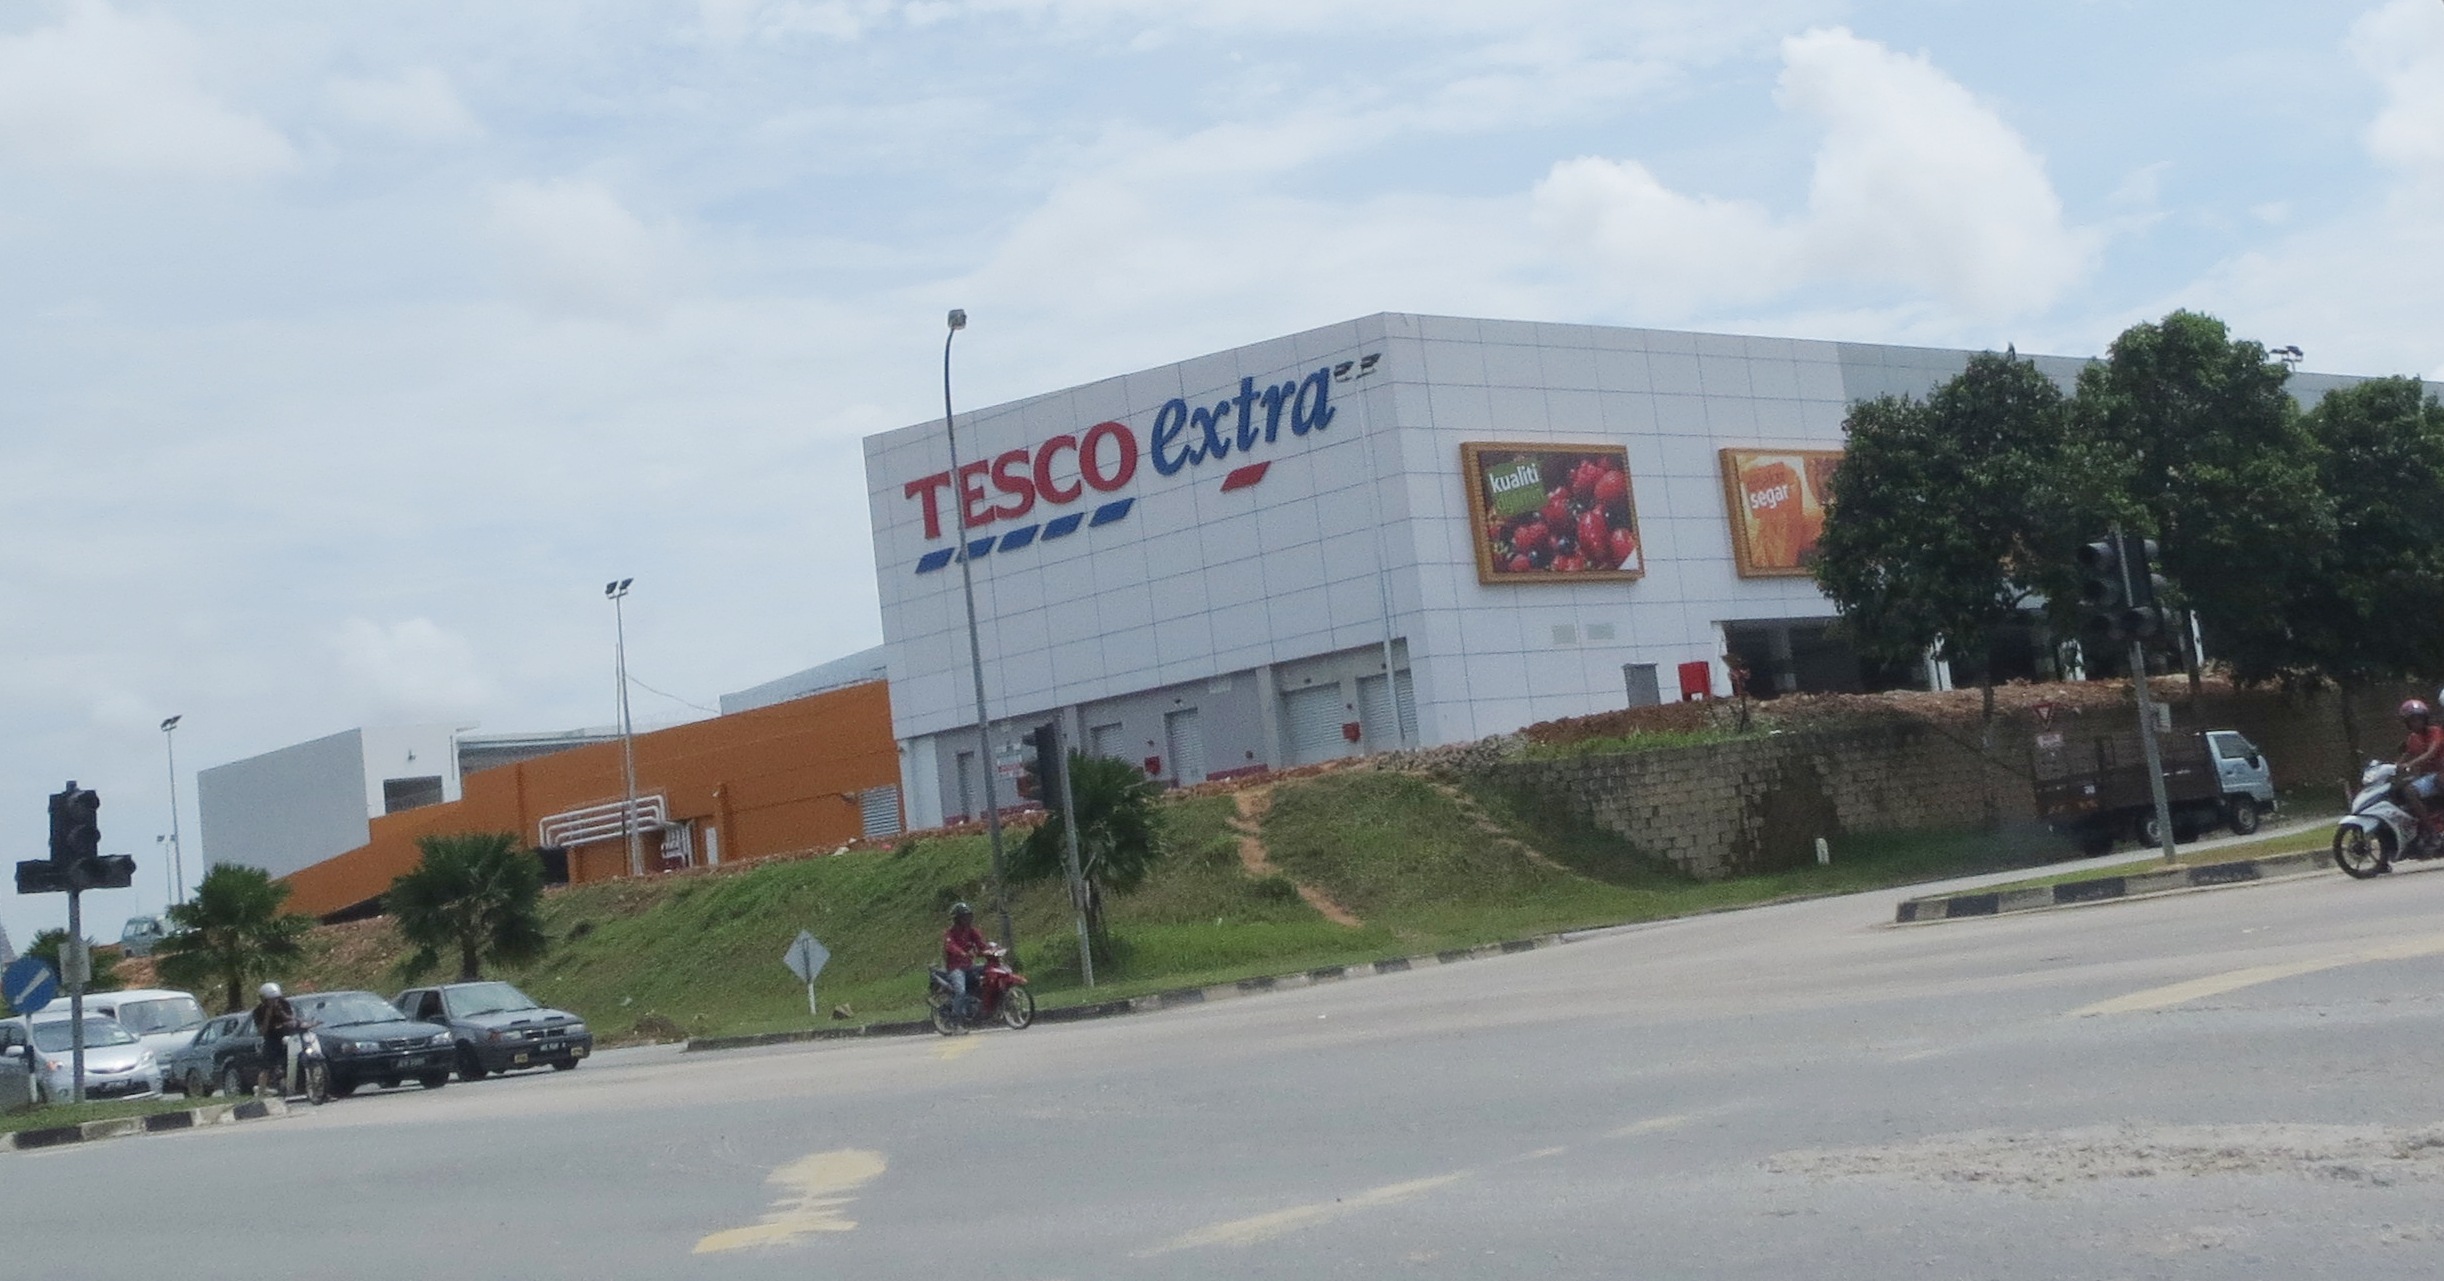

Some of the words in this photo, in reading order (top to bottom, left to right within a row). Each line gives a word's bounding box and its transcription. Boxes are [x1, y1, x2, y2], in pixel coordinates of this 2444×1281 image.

[904, 421, 1138, 540] TESCO
[1150, 366, 1337, 477] extra
[1489, 463, 1539, 493] kualiti
[1750, 484, 1789, 509] segar
